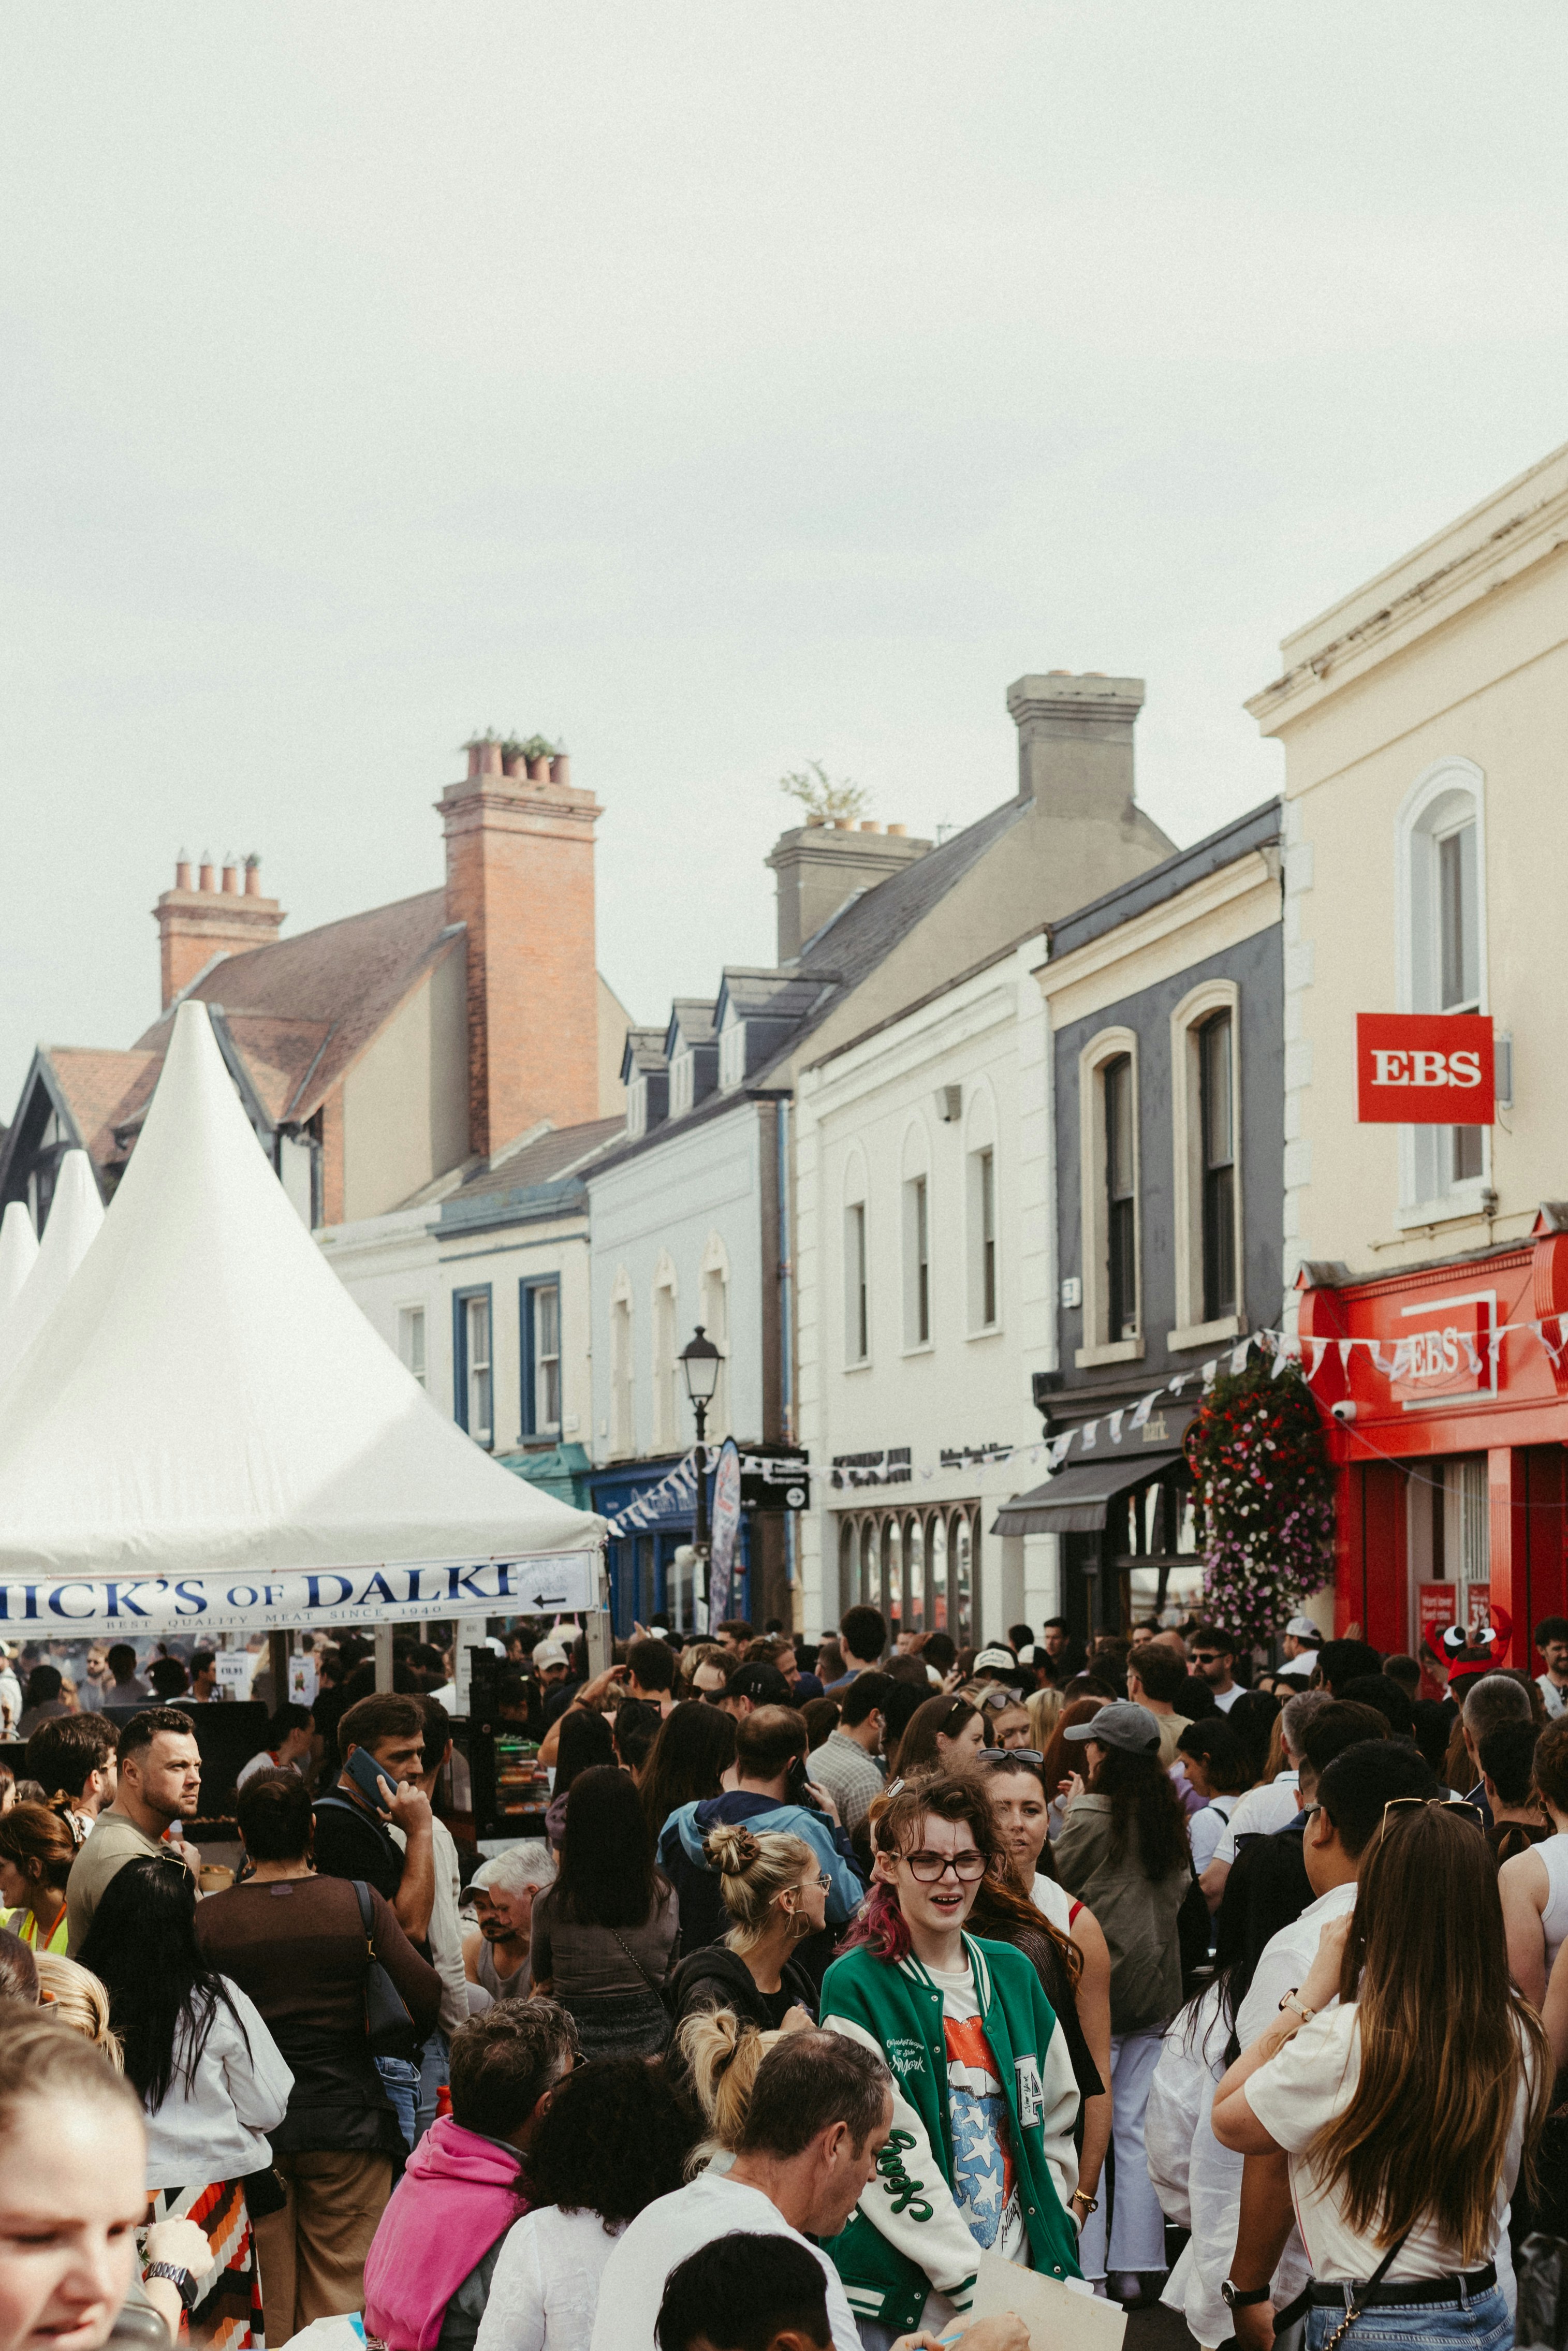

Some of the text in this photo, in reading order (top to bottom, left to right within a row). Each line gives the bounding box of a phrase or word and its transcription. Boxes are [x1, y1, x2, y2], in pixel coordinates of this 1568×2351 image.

[1371, 1050, 1482, 1089] EBS
[1407, 1326, 1460, 1379] EBS
[226, 1584, 285, 1607] OF
[106, 1606, 442, 1629] BEST QUALITY MEAT SINCE 1940
[1014, 2053, 1045, 2130] A
